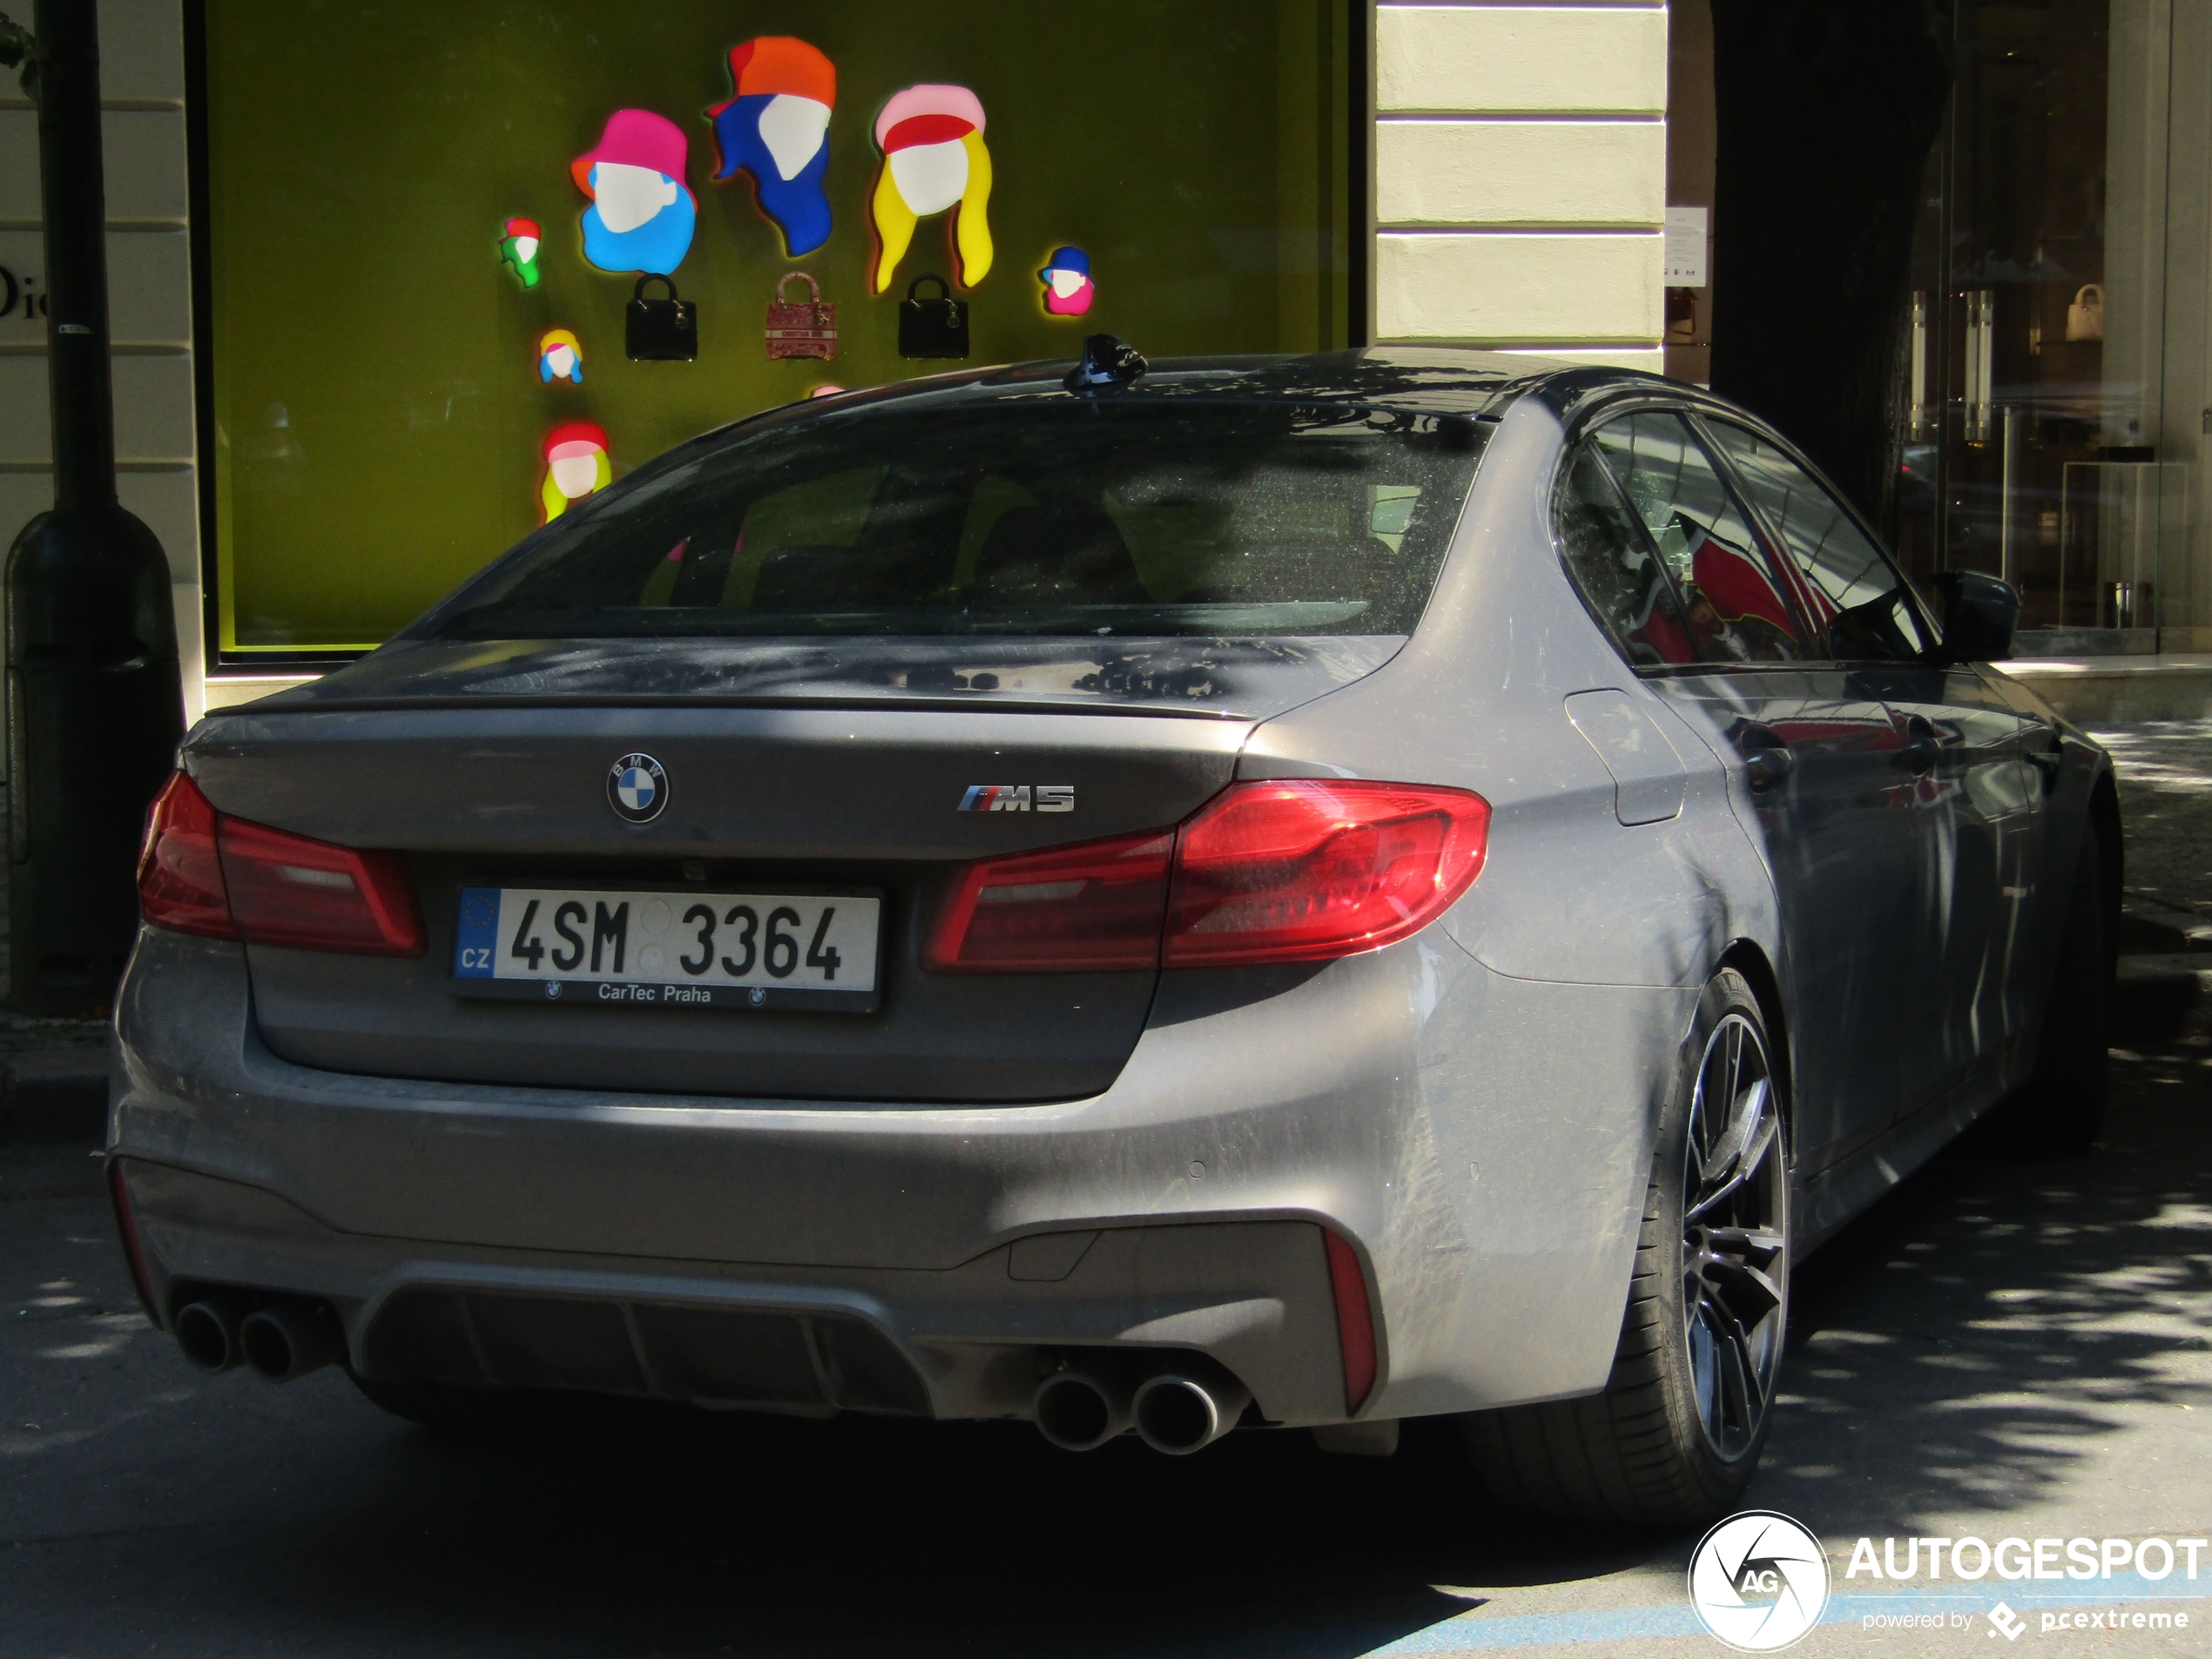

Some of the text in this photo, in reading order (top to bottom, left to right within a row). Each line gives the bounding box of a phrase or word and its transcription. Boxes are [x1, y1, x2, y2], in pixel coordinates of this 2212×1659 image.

[613, 756, 662, 778] BMW
[988, 786, 1074, 813] M5
[511, 900, 841, 980] 4SM 3364
[462, 948, 489, 968] CZ
[598, 983, 711, 1002] CarTec Praha
